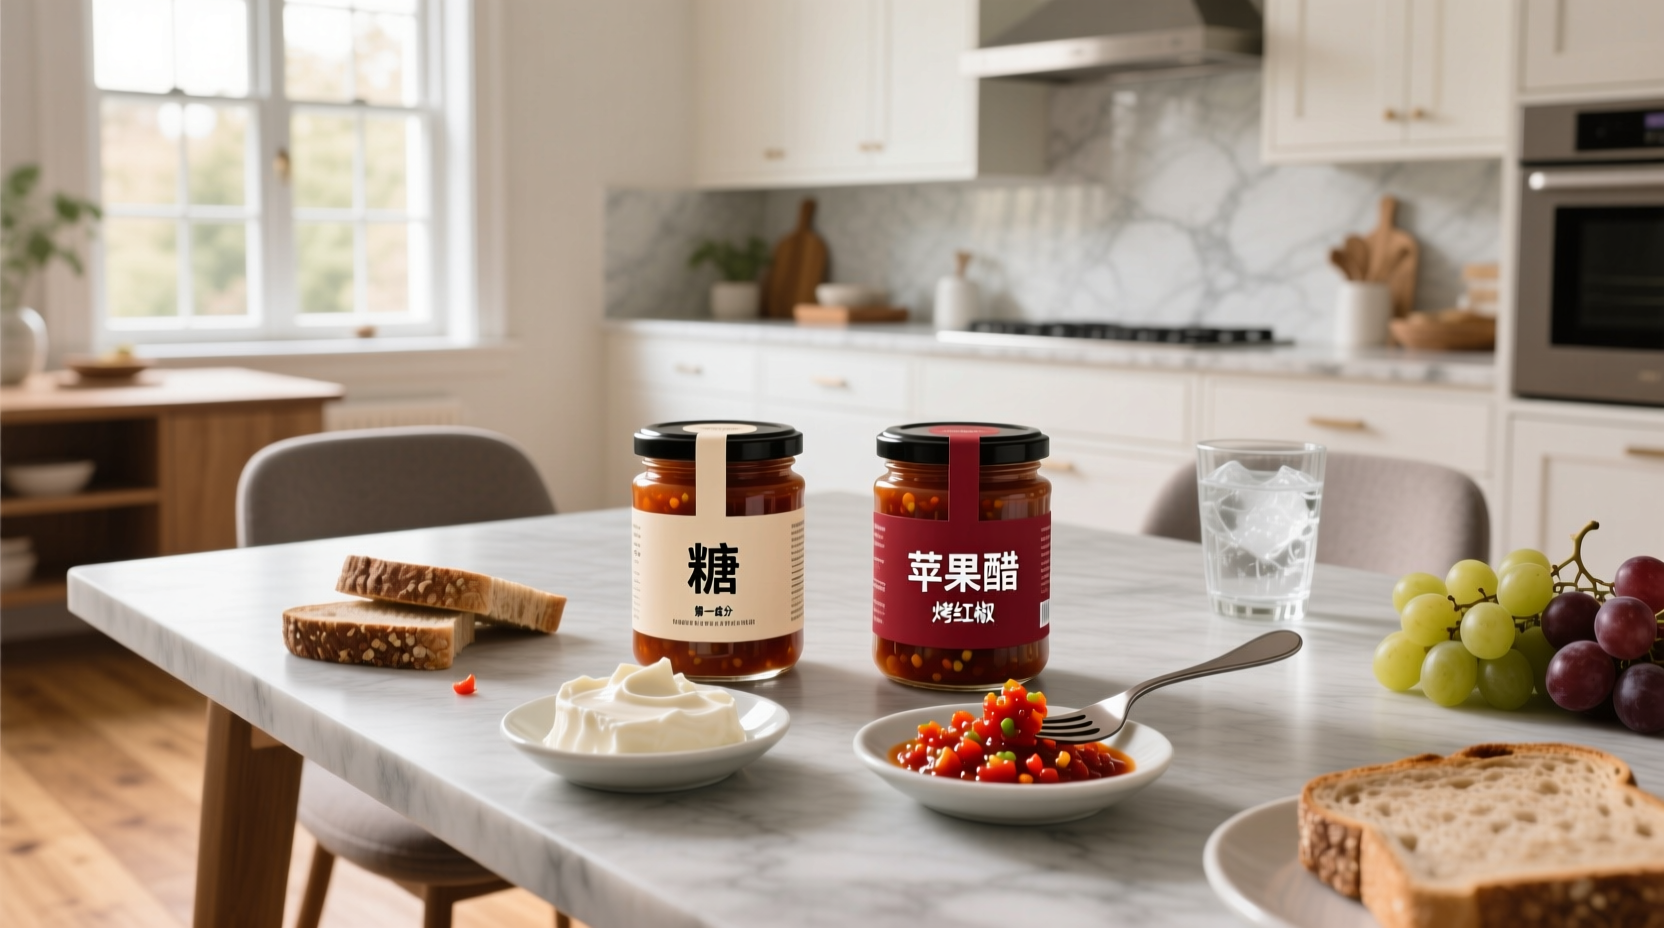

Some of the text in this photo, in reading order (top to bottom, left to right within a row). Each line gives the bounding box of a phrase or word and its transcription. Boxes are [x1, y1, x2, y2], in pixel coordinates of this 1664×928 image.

[687, 542, 739, 595] 糖
[907, 550, 1019, 592] 苹果醋
